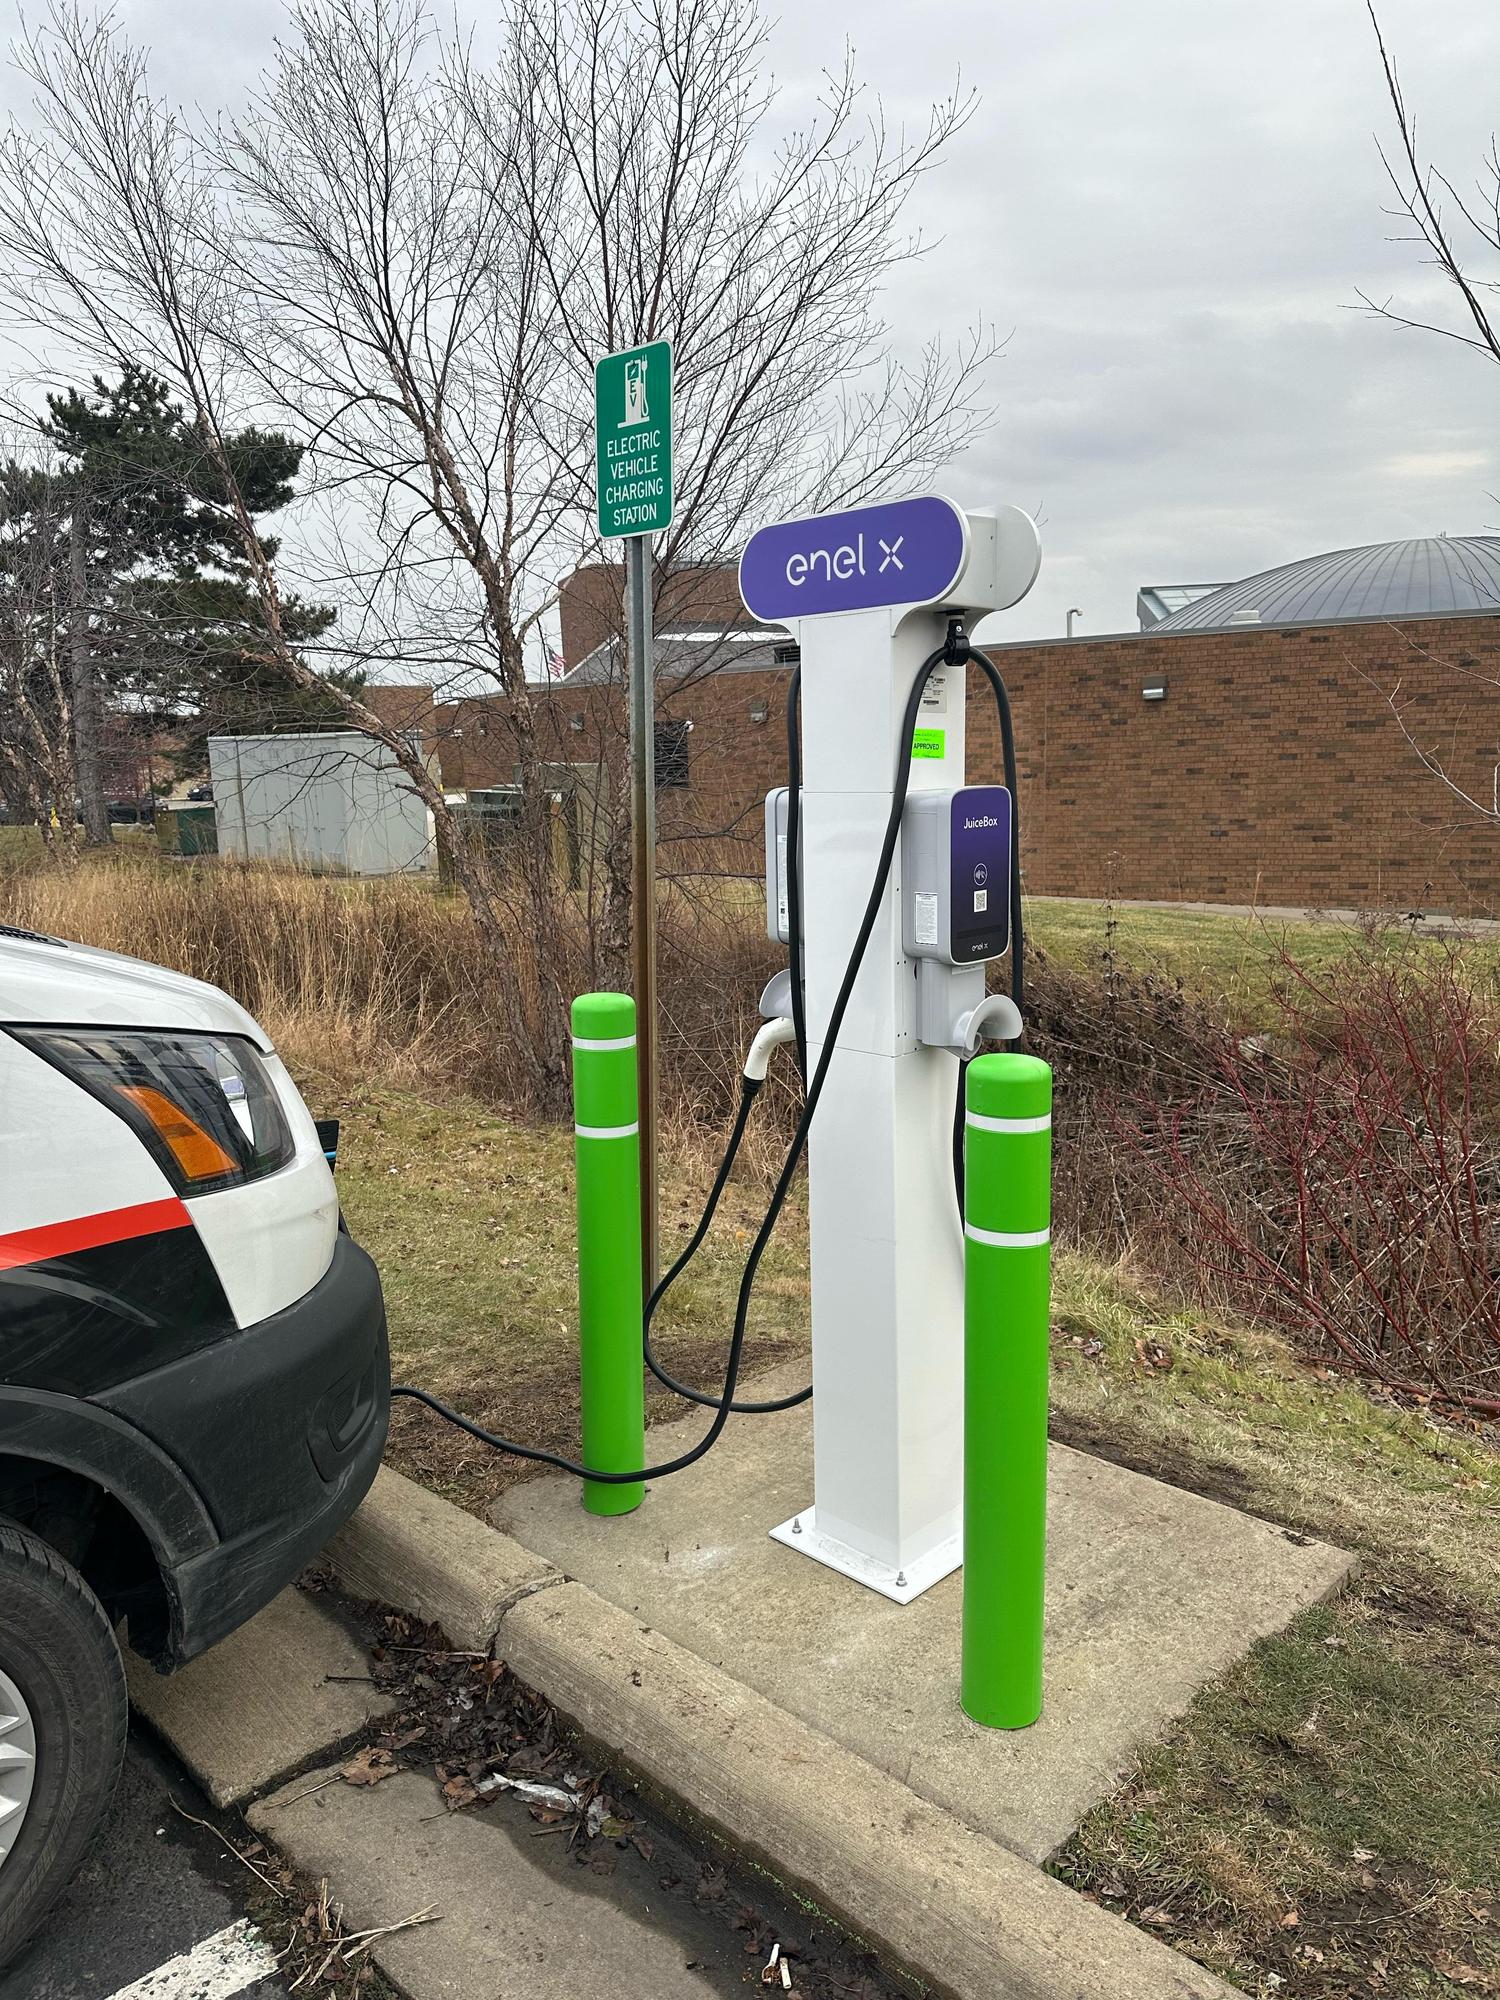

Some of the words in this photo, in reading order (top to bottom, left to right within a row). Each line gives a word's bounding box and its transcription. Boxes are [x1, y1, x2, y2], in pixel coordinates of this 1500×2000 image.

[607, 429, 661, 458] ELECTRIC
[610, 454, 658, 480] VEHICLE
[606, 477, 664, 504] CHARGING
[613, 502, 657, 527] STATION
[786, 533, 866, 586] enel
[913, 743, 940, 751] APPROVED
[963, 816, 998, 829] JuiceBox
